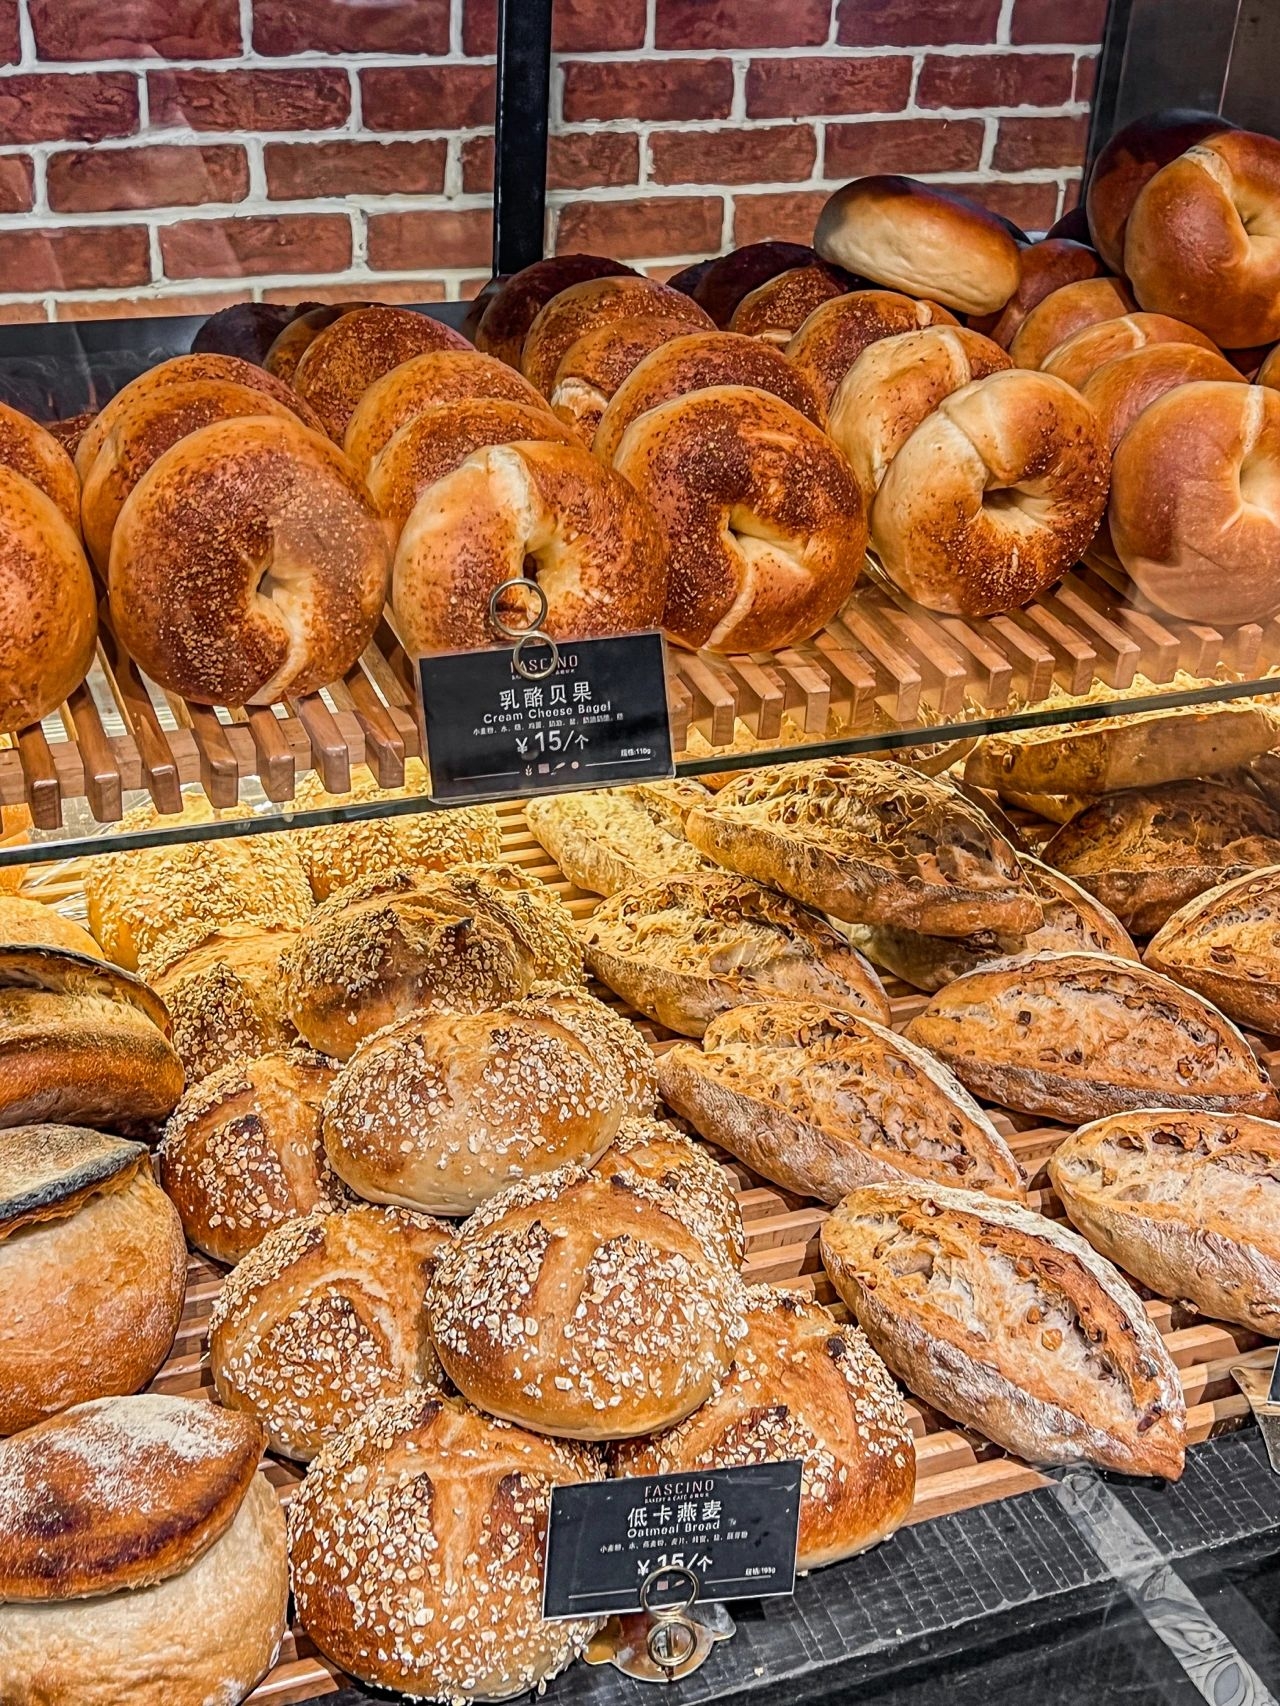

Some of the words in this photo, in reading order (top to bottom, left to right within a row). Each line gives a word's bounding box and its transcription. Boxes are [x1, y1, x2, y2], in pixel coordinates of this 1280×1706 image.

[499, 681, 592, 711] 乳酪贝果
[483, 712, 523, 724] Cream
[528, 706, 573, 719] Cheese
[578, 701, 611, 715] Bagel
[644, 1479, 714, 1498] FASCINO
[627, 1499, 722, 1528] 低卡燕麦
[627, 1524, 679, 1538] Oatmeal
[684, 1520, 720, 1534] Bread
